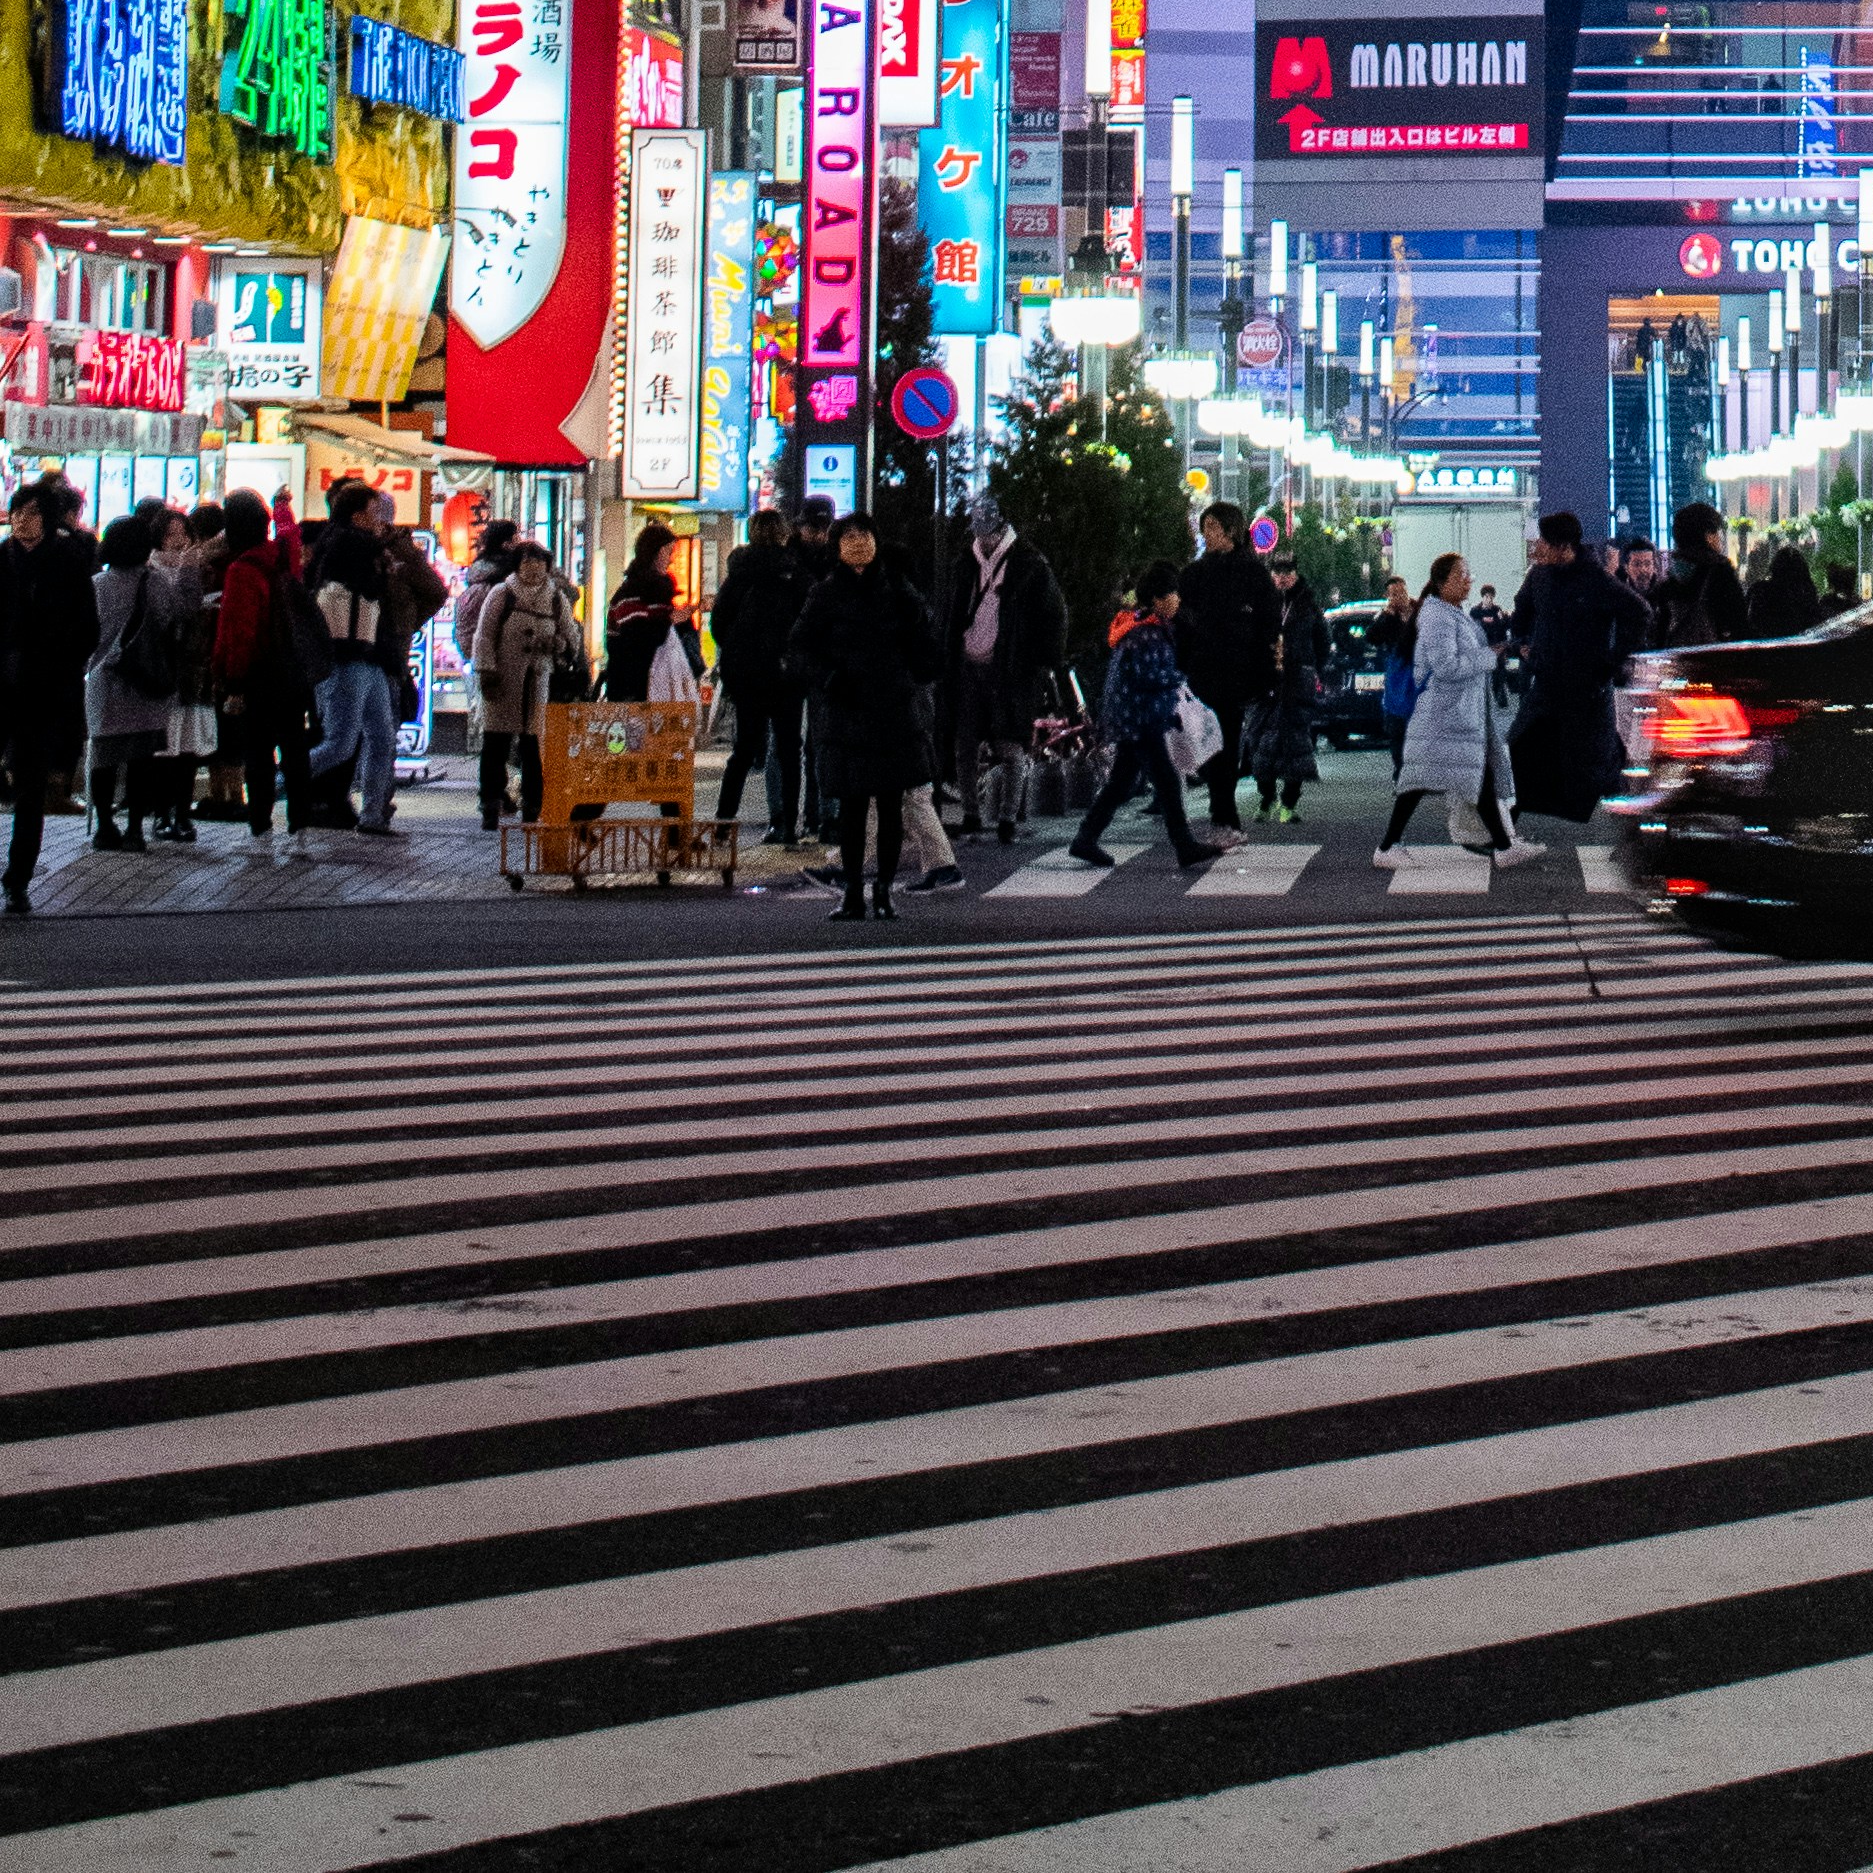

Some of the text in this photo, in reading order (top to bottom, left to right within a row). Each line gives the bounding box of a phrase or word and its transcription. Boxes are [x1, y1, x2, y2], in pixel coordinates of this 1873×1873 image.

[1349, 40, 1528, 89] MARUHAN
[1299, 125, 1517, 150] 2F店舗出入口はビル左側
[814, 86, 860, 286] ROAD
[505, 183, 552, 285] やきとり
